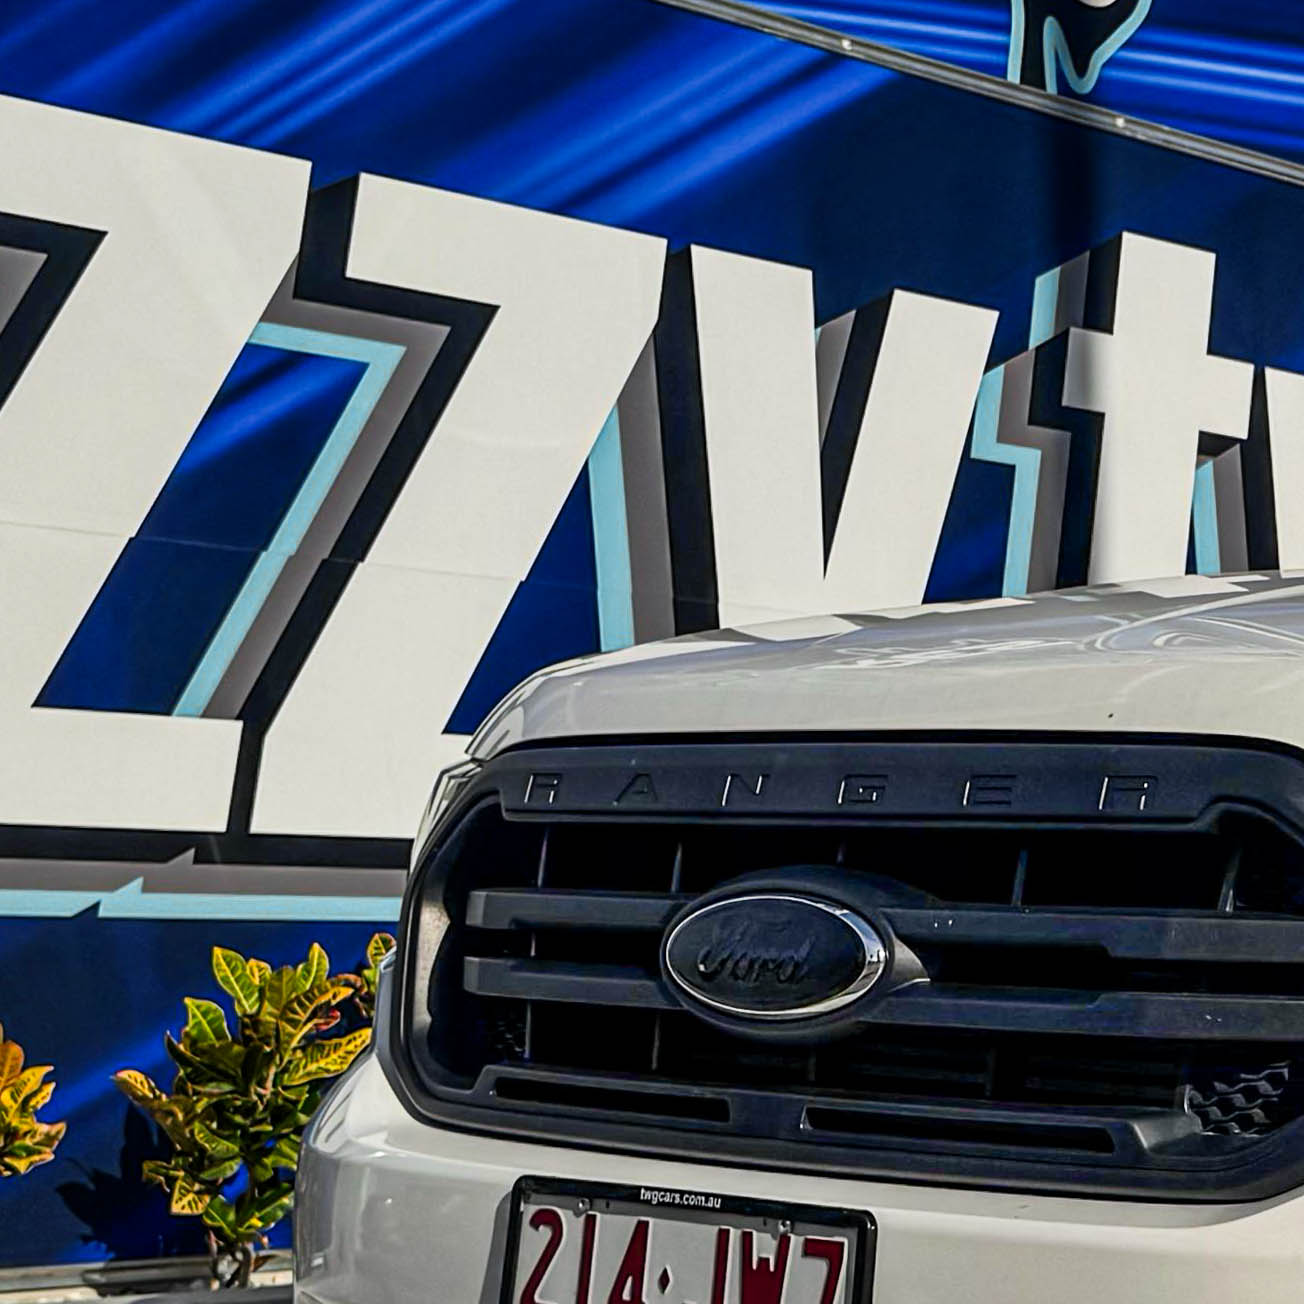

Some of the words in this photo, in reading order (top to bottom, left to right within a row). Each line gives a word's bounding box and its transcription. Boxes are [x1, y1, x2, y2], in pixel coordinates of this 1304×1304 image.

[524, 771, 1160, 812] RANGER
[697, 914, 817, 985] Ford
[639, 1187, 722, 1210] twgcars.com.au
